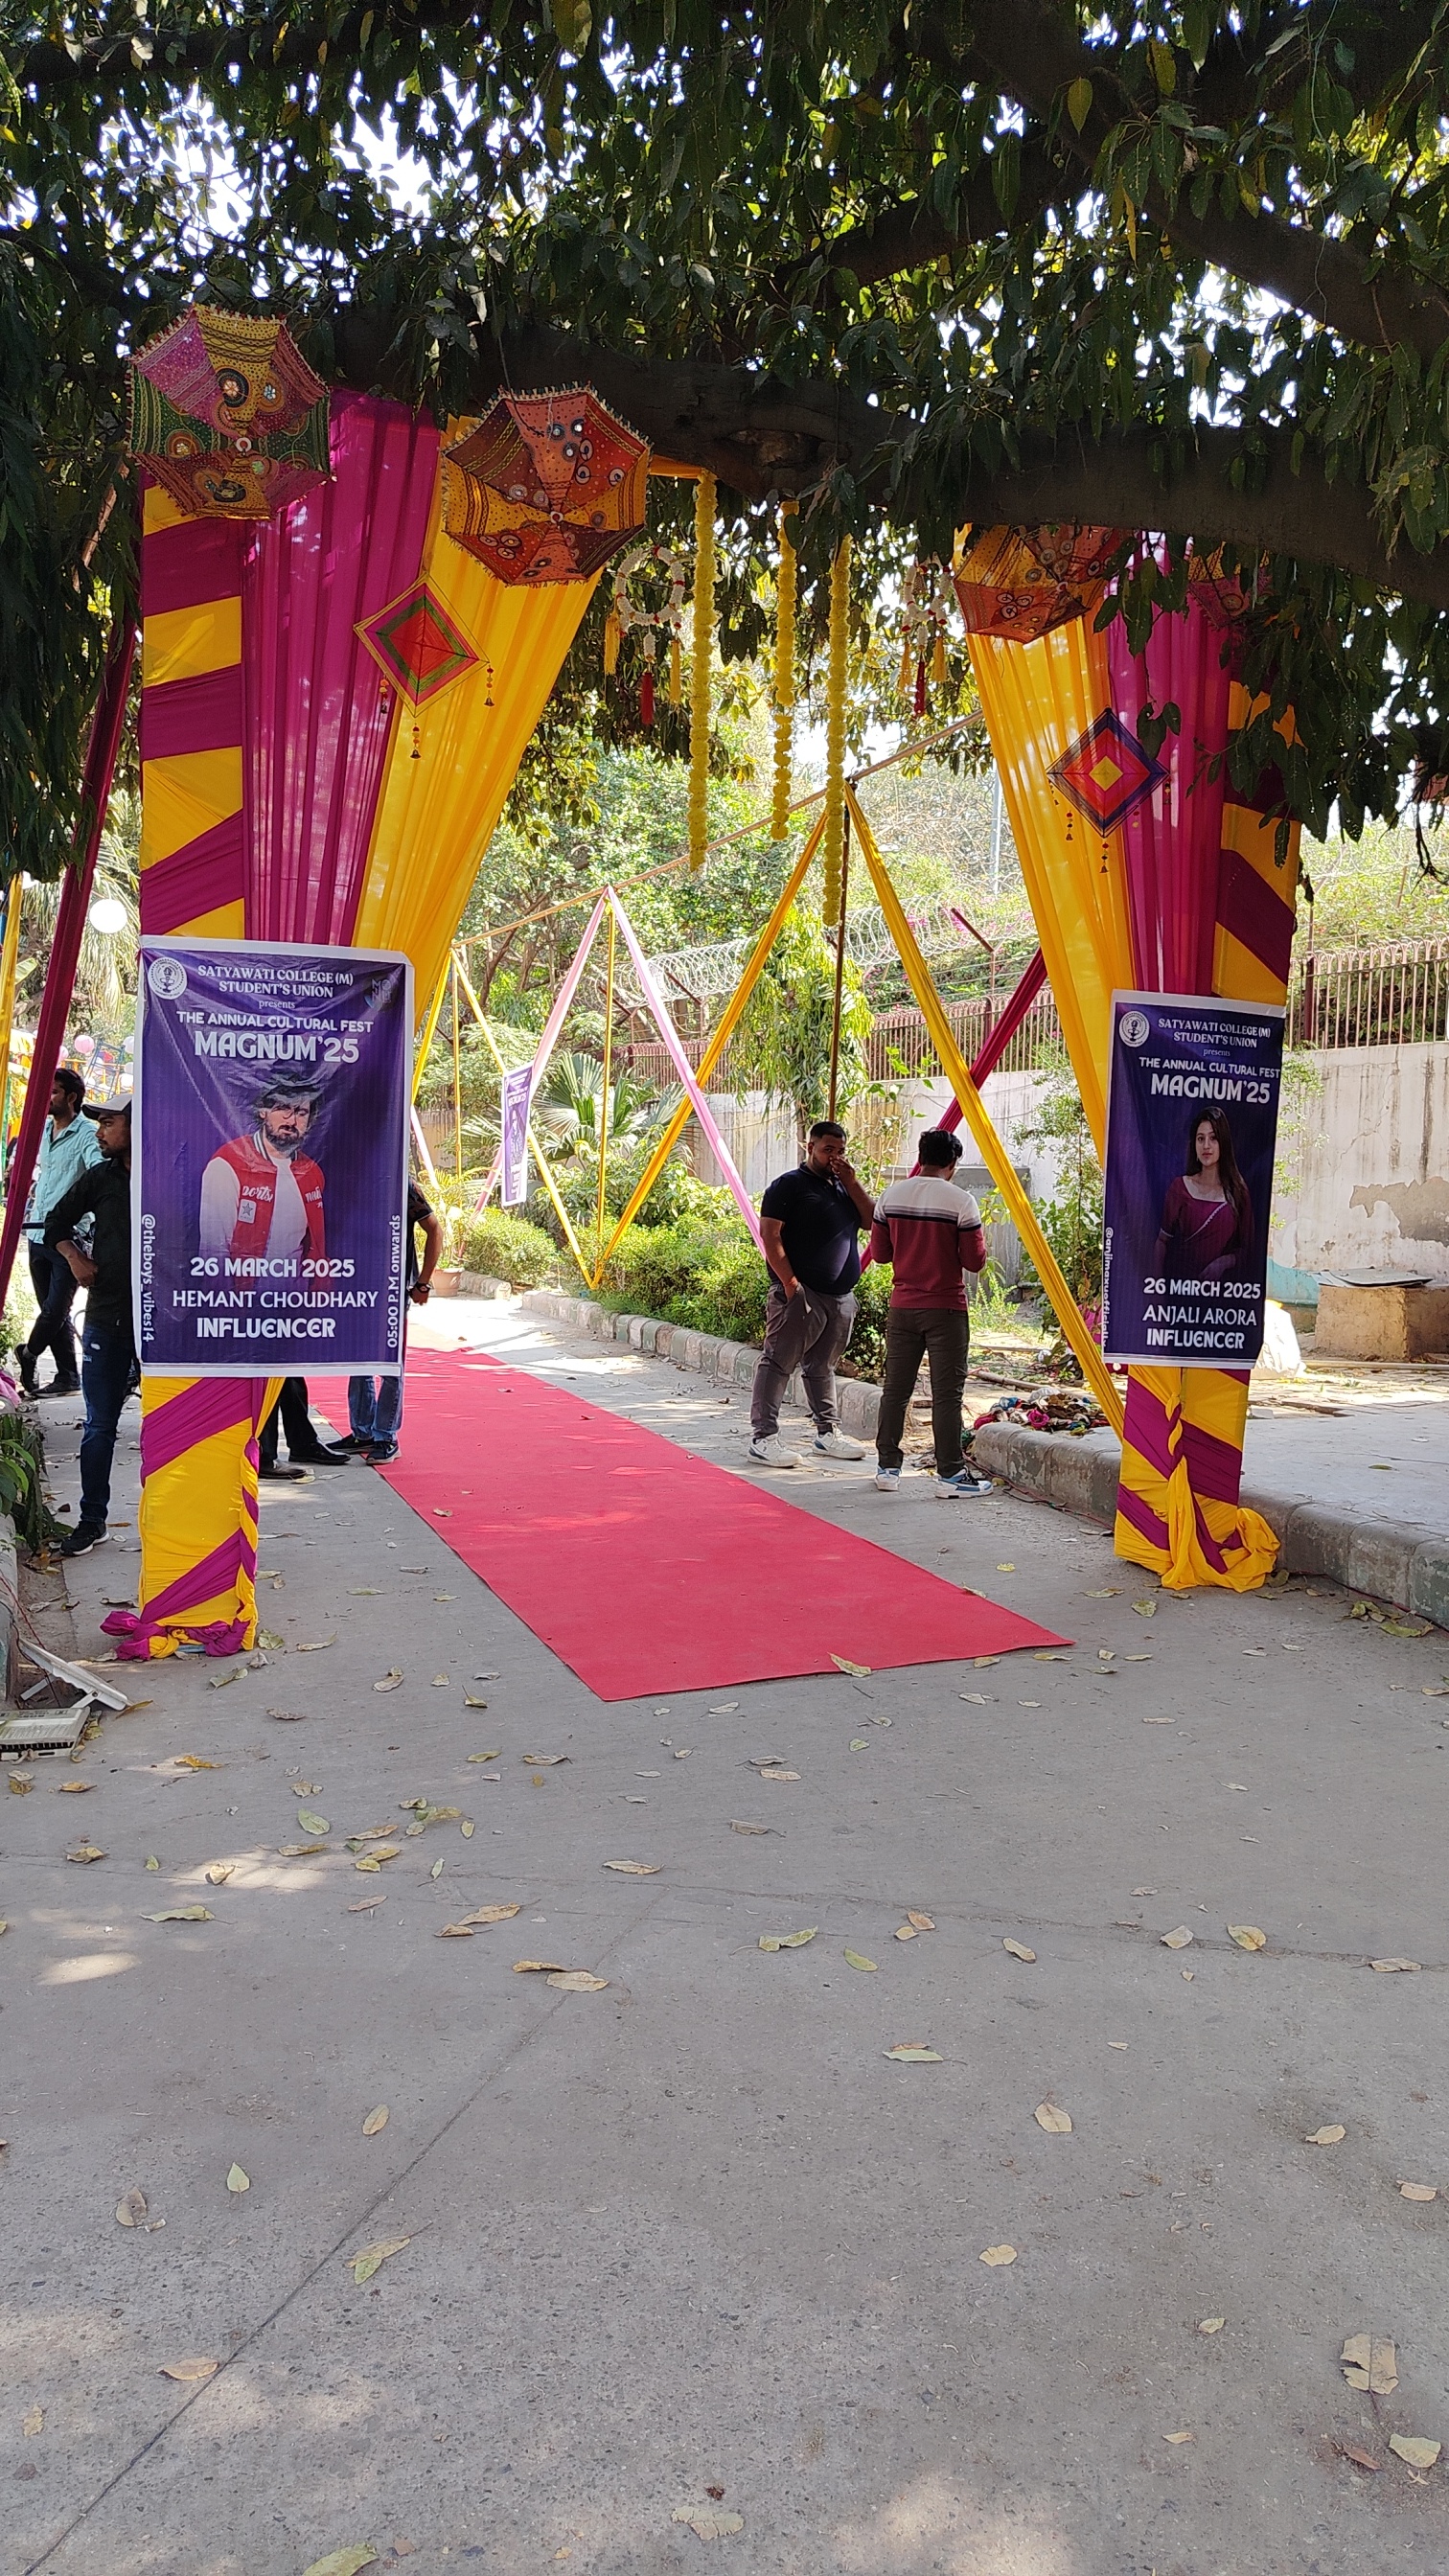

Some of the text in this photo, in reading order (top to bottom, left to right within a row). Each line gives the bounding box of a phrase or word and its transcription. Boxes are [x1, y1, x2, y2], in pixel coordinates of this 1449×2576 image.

[198, 965, 354, 986] SATYAWATI COLLEGE (M)
[218, 980, 334, 998] STUDENT'S UNION
[259, 999, 295, 1009] presents
[176, 1011, 374, 1033] THE ANNUAL CULTURAL FEST
[1158, 1018, 1218, 1032] SATYAWATI
[1219, 1023, 1258, 1036] COLLEGE
[1258, 1026, 1271, 1038] (M)
[195, 1031, 359, 1063] MAGNUM'25
[1173, 1031, 1257, 1048] STUDENT'S UNION
[1203, 1047, 1230, 1057] presents
[1138, 1056, 1280, 1079] THE ANNUAL CULTURAL FEST
[1150, 1073, 1271, 1104] MAGNUM'25
[389, 1215, 401, 1274] onwards
[190, 1257, 356, 1277] 26 MARCH 2025
[141, 1214, 156, 1342] @theboys_vibes14
[1143, 1277, 1261, 1299] 26 MARCH 2025
[172, 1291, 379, 1308] HEMANT CHOUDHARY
[1142, 1304, 1257, 1326] ANJALI ARORA
[196, 1318, 336, 1338] INFLUENCER
[387, 1306, 399, 1348] 05:00
[1146, 1328, 1245, 1349] INFLUENCER
